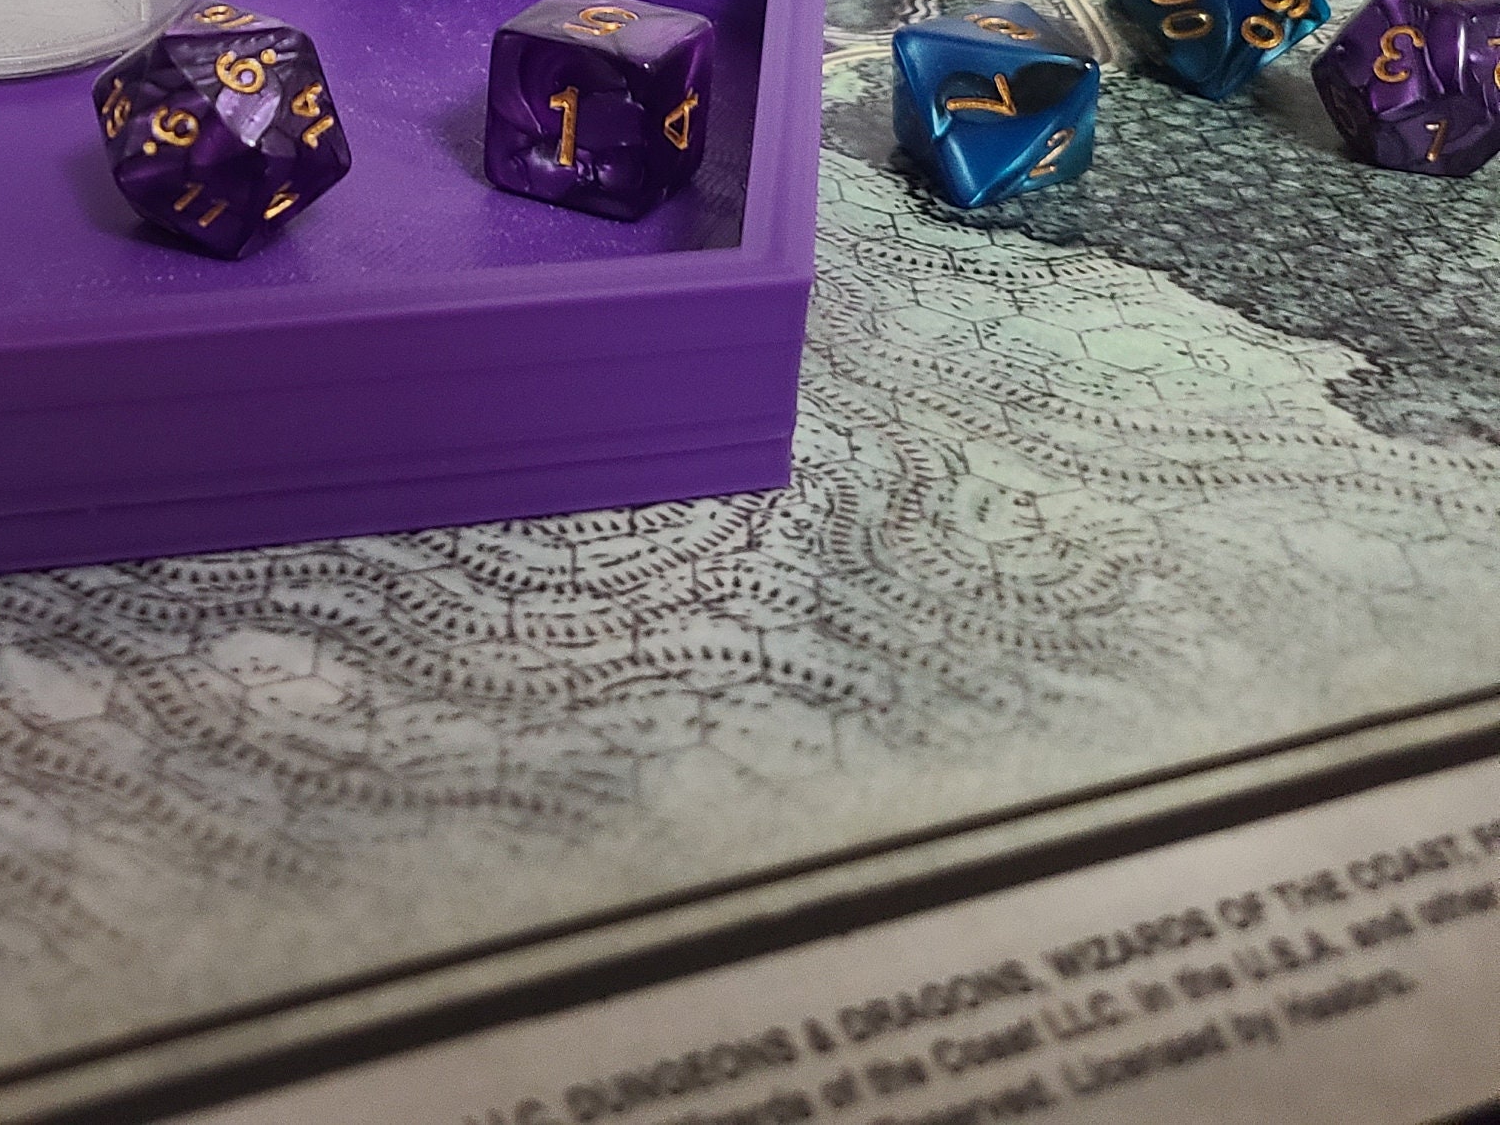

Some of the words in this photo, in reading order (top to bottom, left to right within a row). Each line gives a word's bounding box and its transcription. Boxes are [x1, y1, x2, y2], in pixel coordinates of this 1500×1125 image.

[548, 84, 581, 167] 1
[1217, 892, 1266, 930] OF
[1270, 868, 1348, 913] THE
